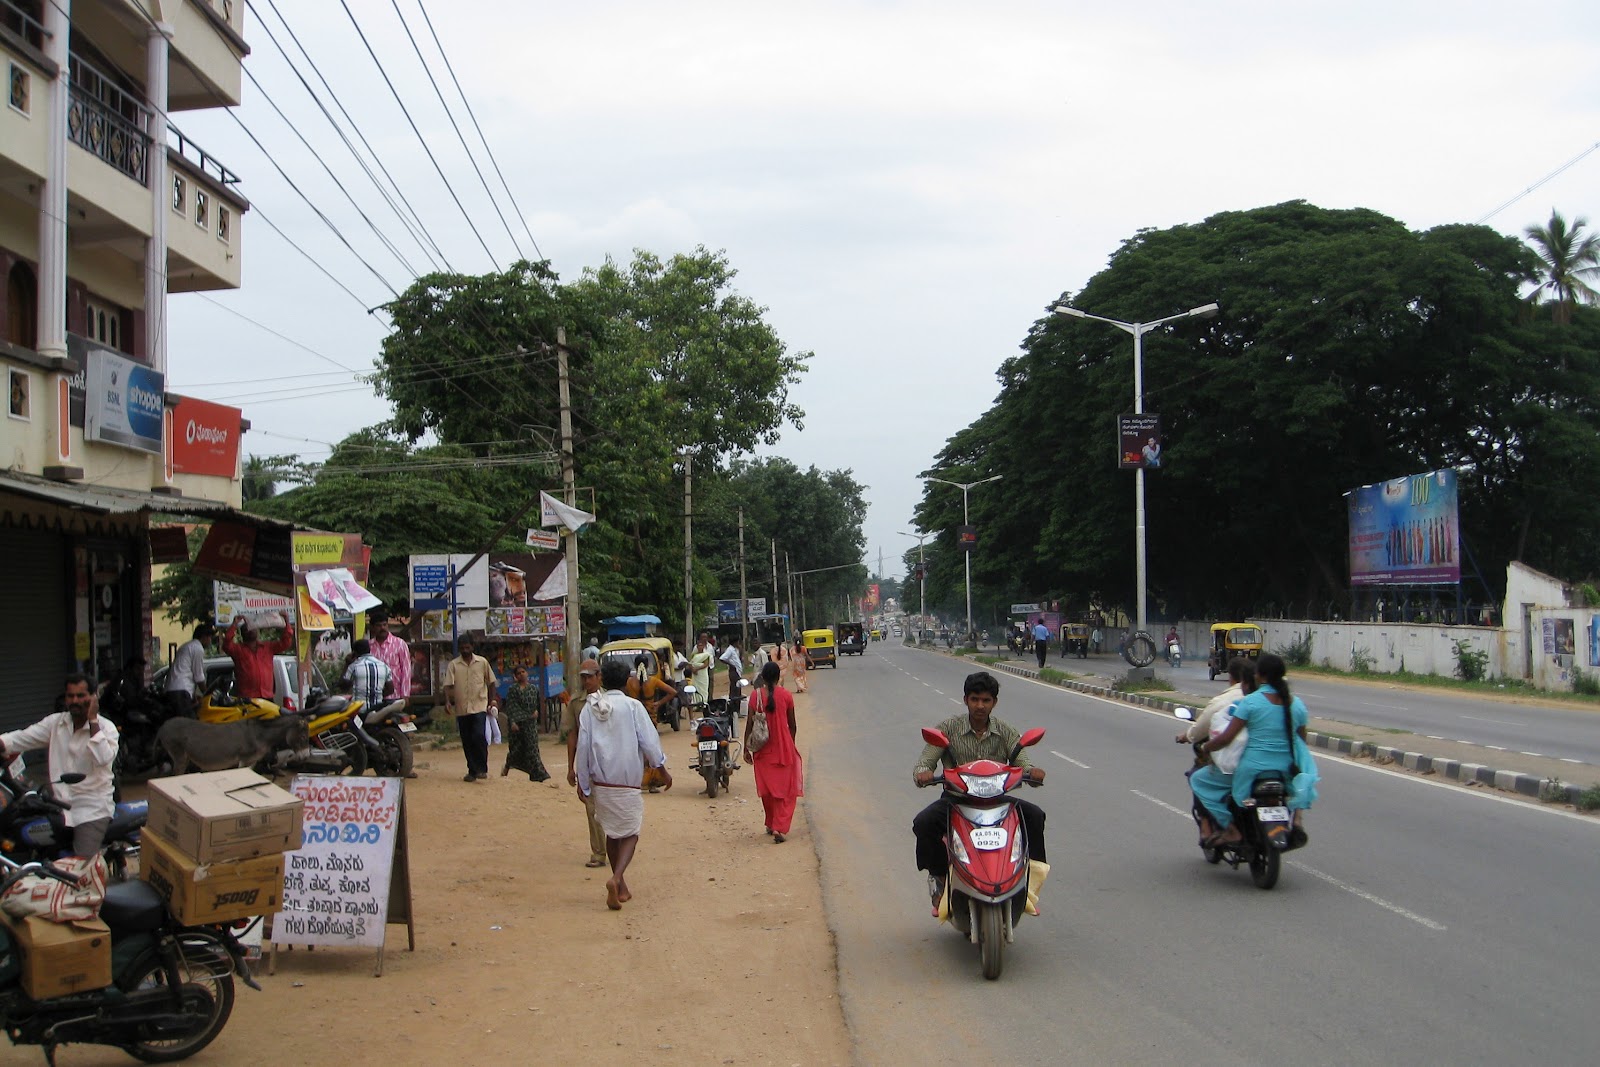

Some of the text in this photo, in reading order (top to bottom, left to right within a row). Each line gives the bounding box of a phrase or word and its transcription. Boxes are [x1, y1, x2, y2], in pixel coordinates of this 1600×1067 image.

[108, 390, 120, 406] BSNL
[130, 384, 161, 412] shoppe
[244, 598, 286, 608] Admissions
[212, 888, 260, 911] Boost
